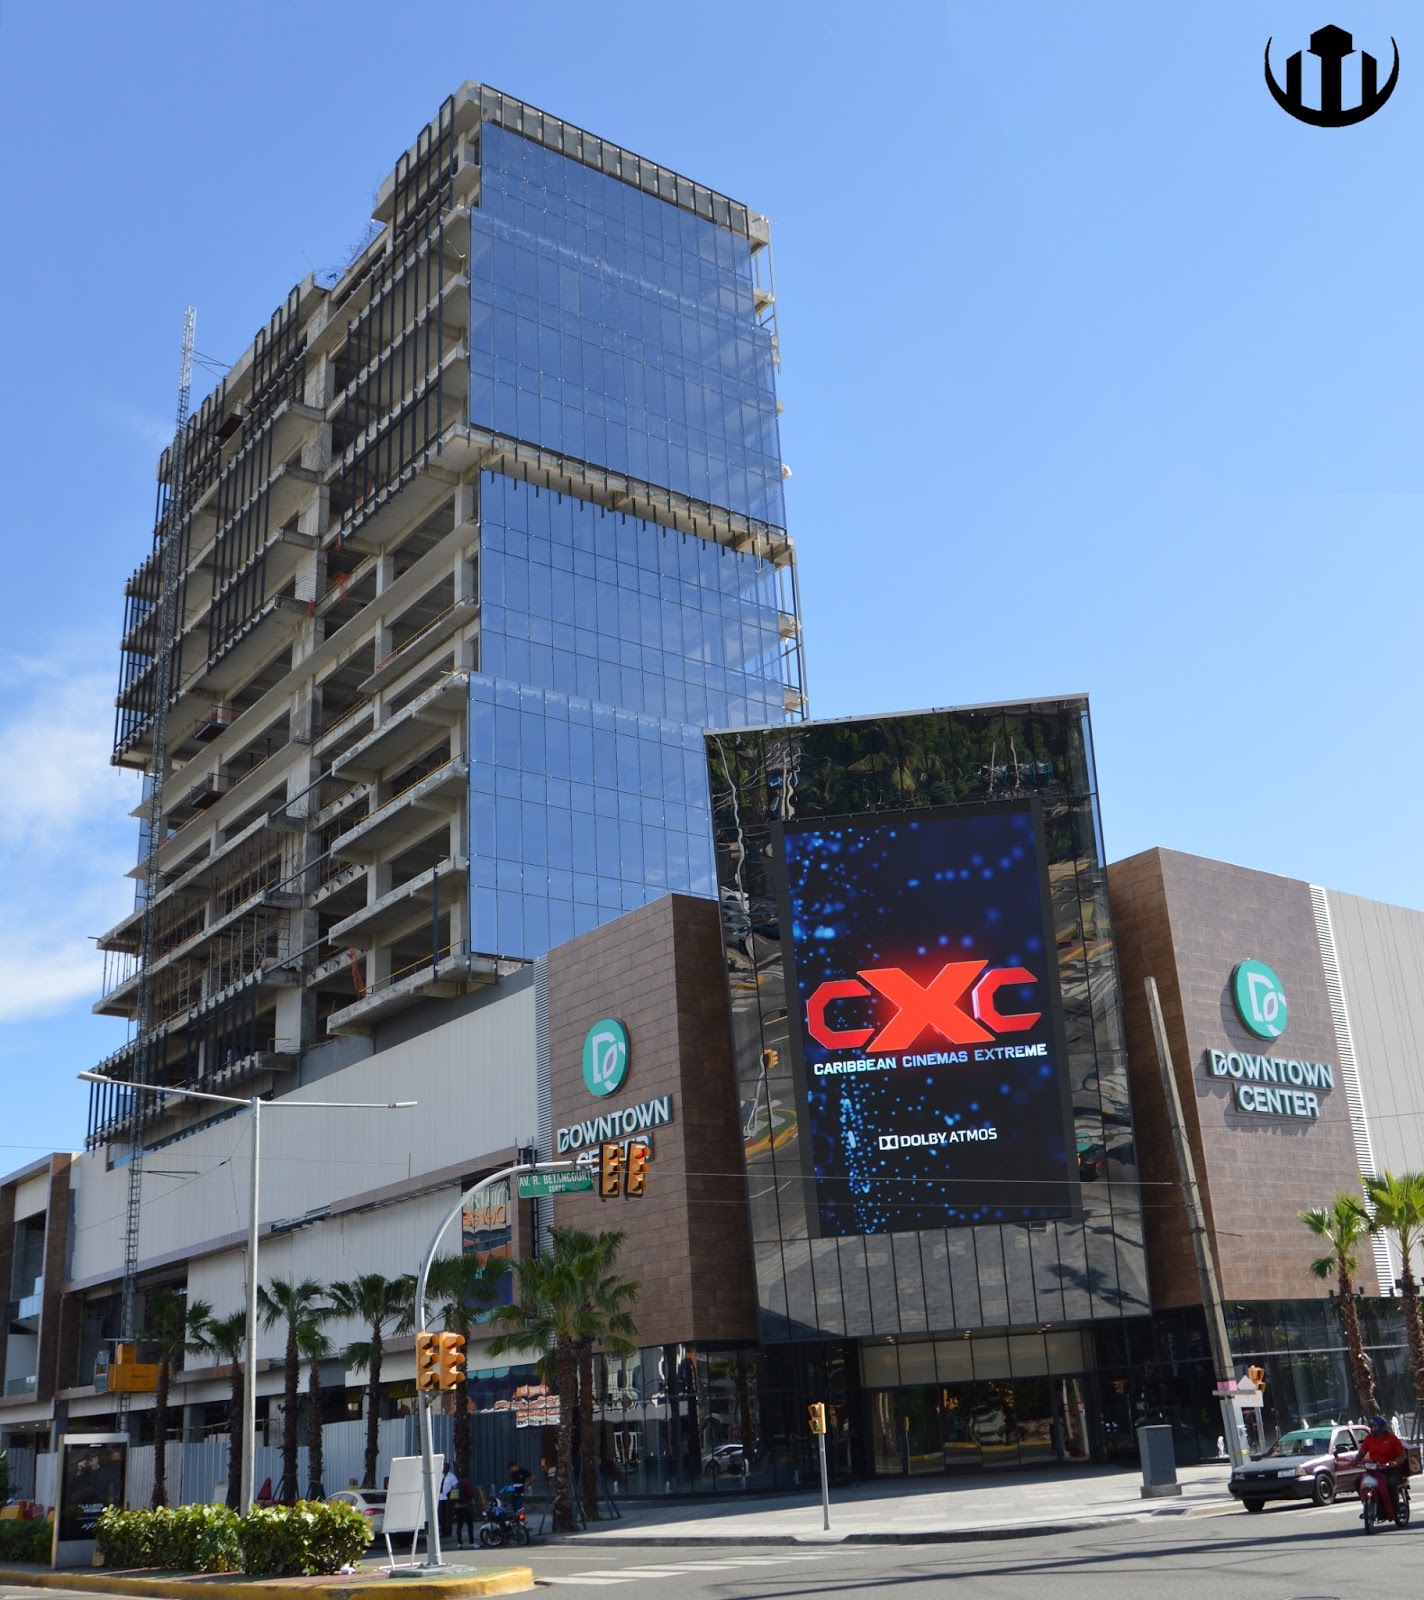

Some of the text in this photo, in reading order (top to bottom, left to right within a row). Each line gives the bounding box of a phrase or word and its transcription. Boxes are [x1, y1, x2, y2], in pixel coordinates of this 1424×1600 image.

[813, 1043, 1048, 1076] CARIBBEAN CINEMAS EXTREME
[1209, 1048, 1335, 1089] DOWNTOWN
[1238, 1084, 1320, 1117] CENTER
[556, 1096, 669, 1154] DOWNTOWN
[900, 1127, 998, 1148] DOLBY ATMOS
[519, 1169, 592, 1187] AV. R. BETANCOURT
